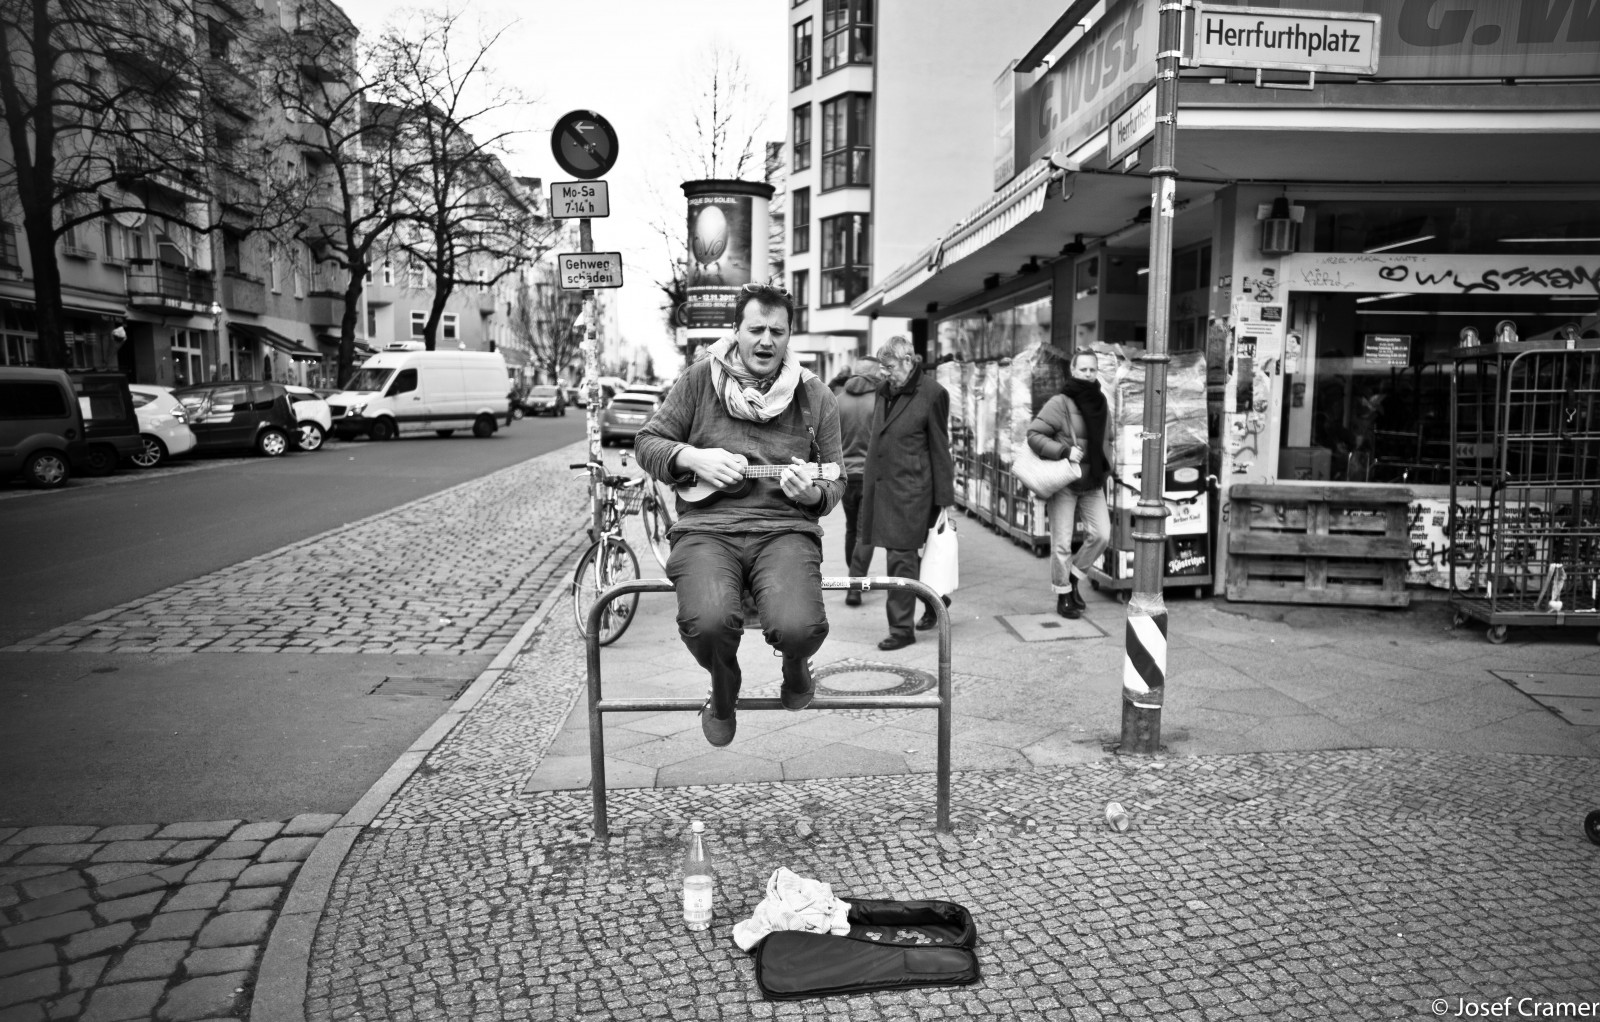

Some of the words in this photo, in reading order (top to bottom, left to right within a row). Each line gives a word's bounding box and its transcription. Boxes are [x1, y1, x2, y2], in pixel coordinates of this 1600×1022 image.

[1206, 18, 1361, 57] Herrfurthplatz
[563, 185, 595, 198] Mo-Sa
[565, 202, 585, 214] 7-14
[589, 202, 595, 213] h
[566, 259, 610, 271] Gehweg
[567, 271, 613, 284] schäden
